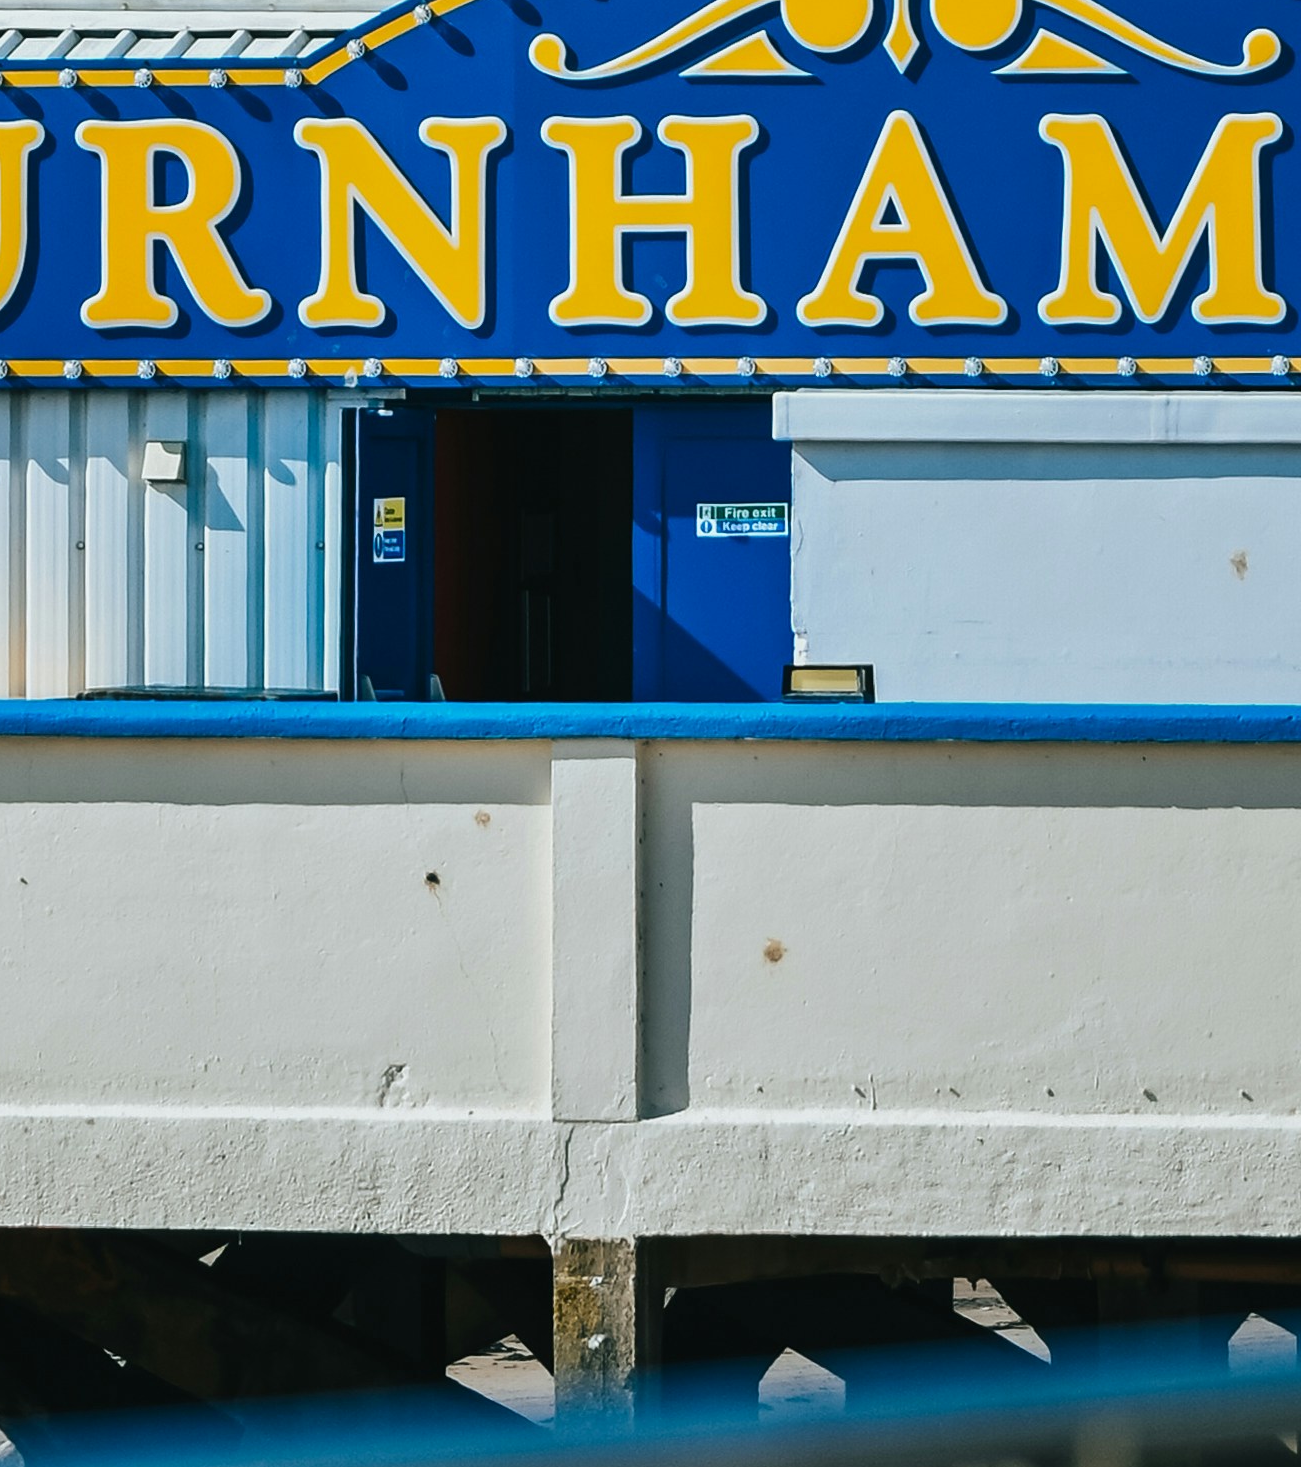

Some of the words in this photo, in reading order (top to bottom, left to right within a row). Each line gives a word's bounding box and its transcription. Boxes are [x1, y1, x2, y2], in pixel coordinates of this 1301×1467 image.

[724, 507, 750, 519] Fire
[752, 507, 776, 518] exit
[722, 521, 750, 532] Keep
[752, 520, 779, 531] clear
